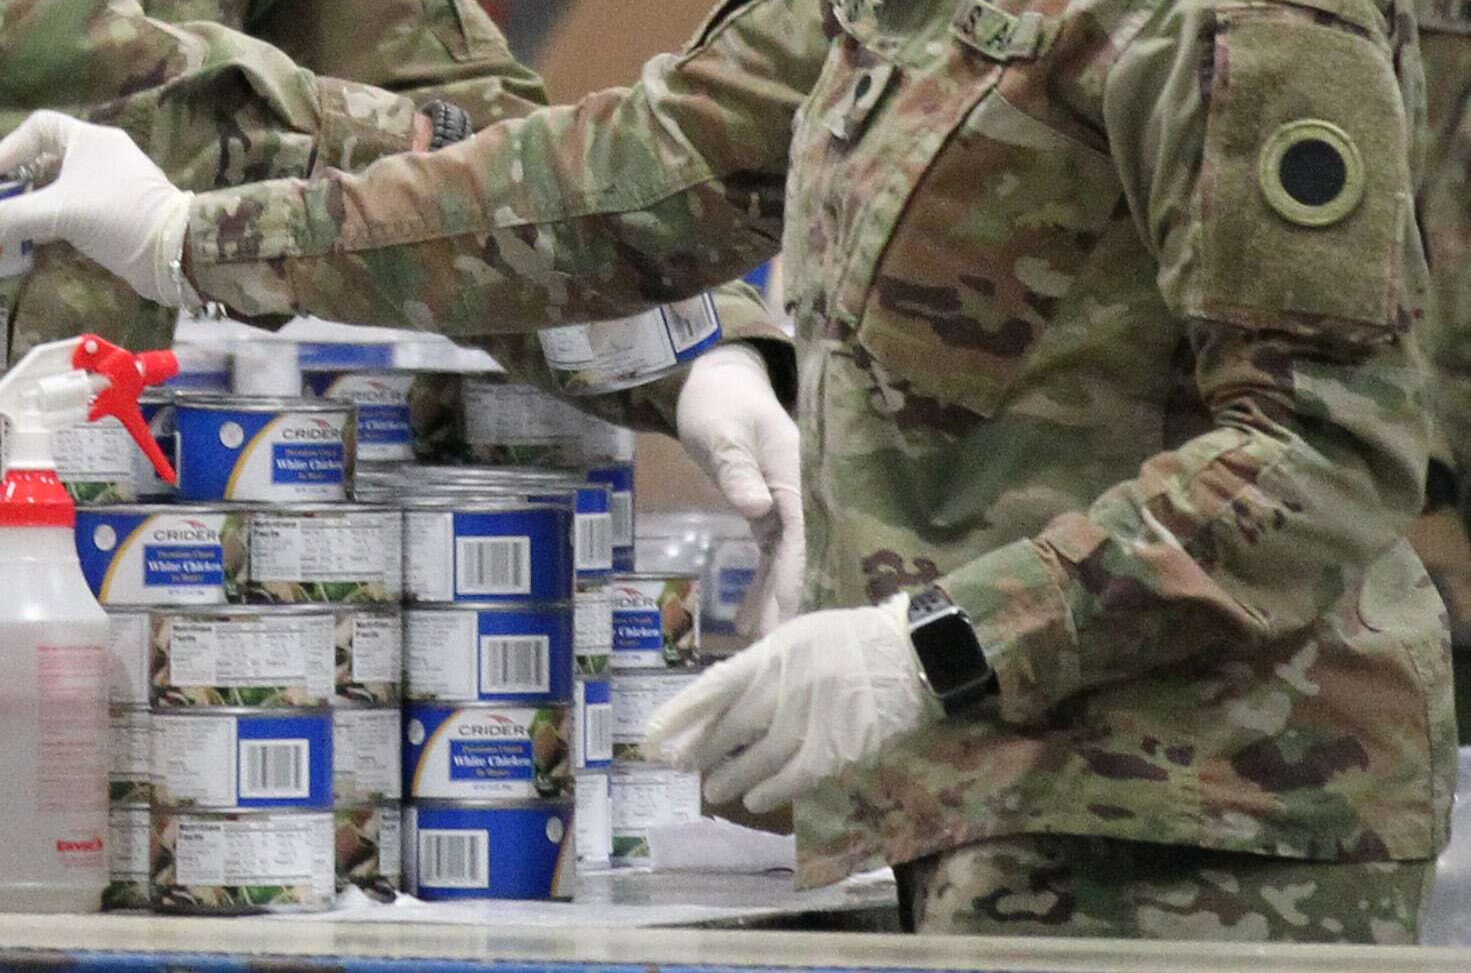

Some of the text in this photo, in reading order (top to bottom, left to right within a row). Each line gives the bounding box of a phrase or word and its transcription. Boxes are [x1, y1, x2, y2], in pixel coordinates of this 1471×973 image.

[282, 427, 342, 439] CRIDER
[153, 529, 218, 541] CRIDER
[458, 724, 526, 736] CRIDER
